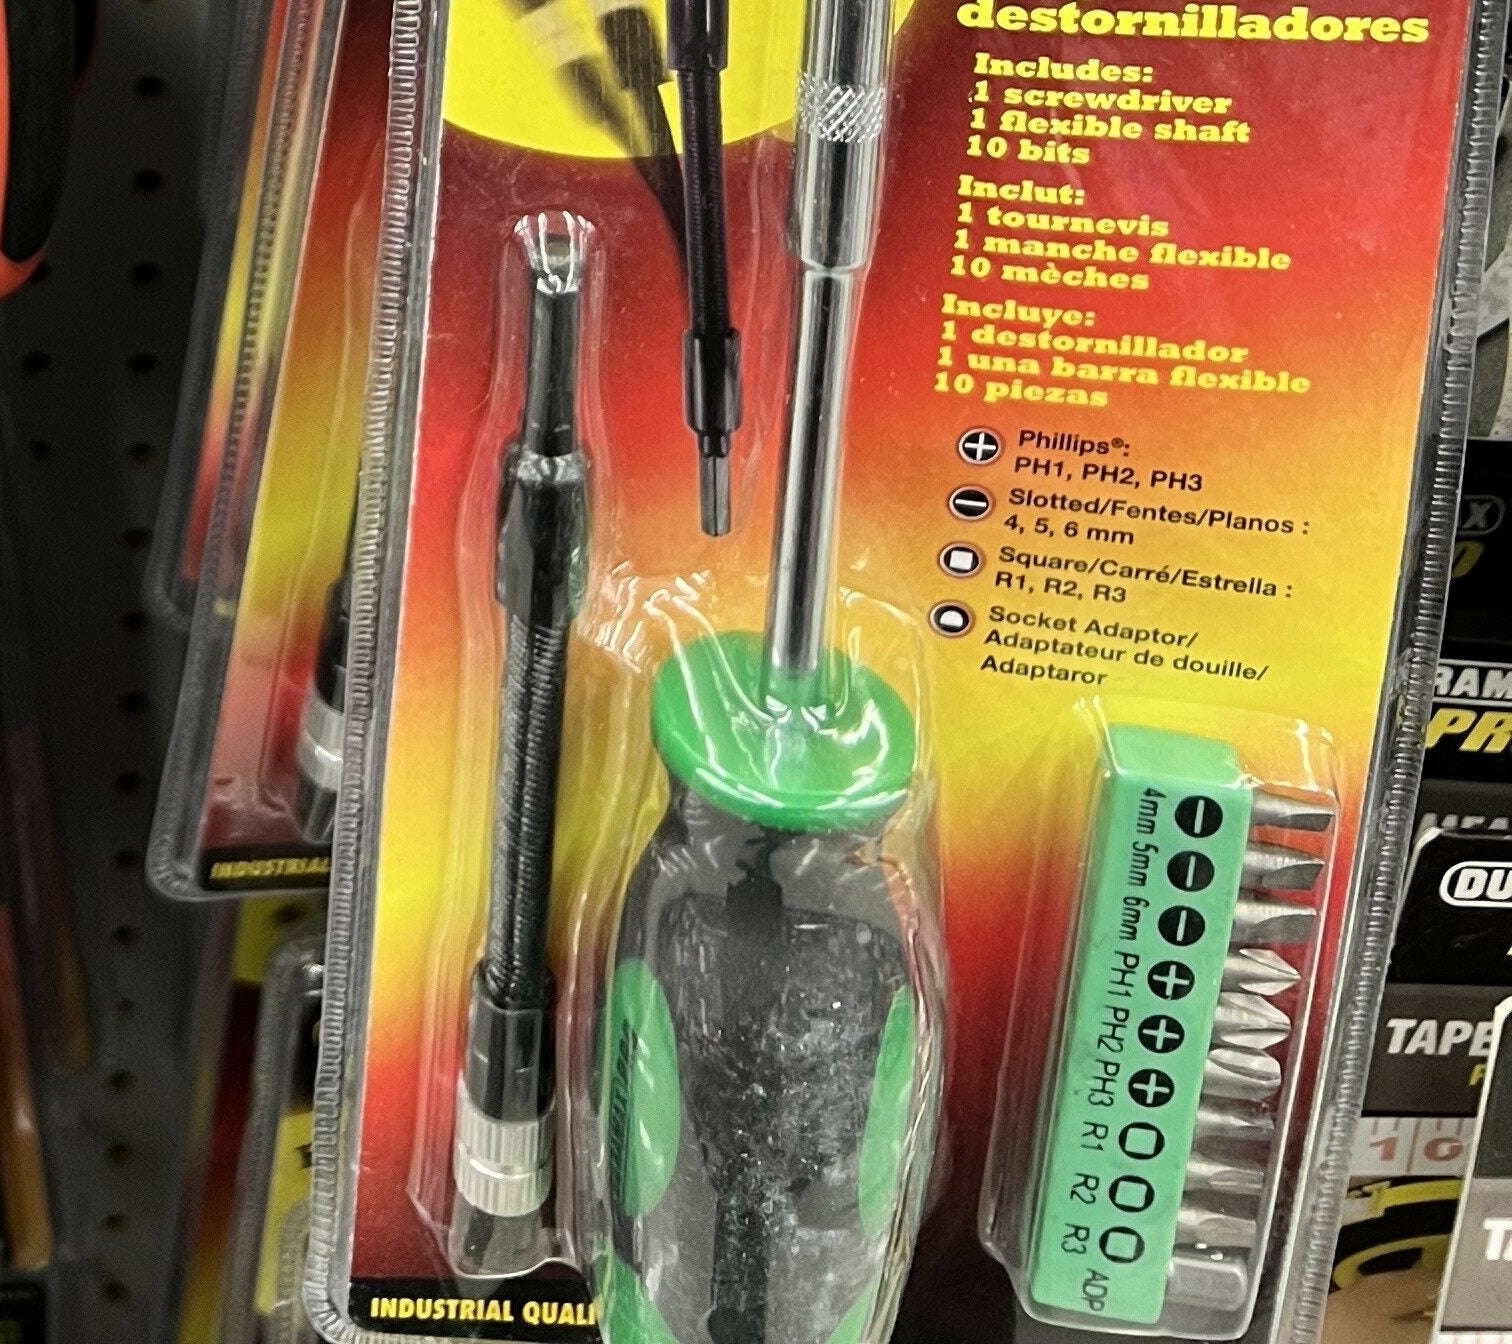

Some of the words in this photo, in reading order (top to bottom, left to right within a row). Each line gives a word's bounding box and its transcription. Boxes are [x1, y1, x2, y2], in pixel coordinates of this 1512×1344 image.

[957, 0, 1430, 45] destornilladores
[975, 53, 1153, 85] Includes:
[974, 82, 990, 103] 1
[1004, 87, 1232, 116] screwdriver
[970, 109, 986, 131] 1
[1000, 111, 1145, 142] flexible
[1155, 120, 1251, 146] shaft
[967, 135, 1007, 161] 10
[1018, 139, 1090, 166] bits
[958, 175, 1086, 207] Inclut:
[958, 203, 974, 224] 1
[987, 208, 1169, 238] tournevis
[954, 229, 970, 250] 1
[984, 234, 1139, 264] manche
[1150, 243, 1291, 272] flexible
[950, 256, 990, 280] 10
[1002, 261, 1149, 292] mèches
[942, 293, 1096, 330] Incluye:
[941, 321, 957, 343] 1
[971, 325, 1249, 365] destornillador
[938, 347, 954, 368] 1
[967, 353, 1040, 377] una
[1053, 358, 1159, 385] barra
[1170, 366, 1311, 394] flexible
[934, 371, 975, 395] 10
[985, 380, 1109, 409] piezas
[1014, 457, 1071, 482] PH1,
[1083, 463, 1141, 489] PH2,
[1151, 470, 1204, 492] PH3
[1004, 515, 1024, 536] 4,
[1035, 518, 1055, 539] 5,
[1065, 522, 1079, 539] 6
[1086, 526, 1135, 546] mm
[1008, 488, 1295, 536] Slotted/Fentes/Planos
[995, 571, 1033, 596] R1,
[1044, 577, 1084, 602] R2,
[1093, 582, 1127, 603] R3
[998, 546, 1277, 598] Square/Carré/Estrella
[990, 605, 1079, 634] Socket
[1084, 615, 1199, 648] Adaptor/
[981, 654, 1108, 686] Adaptaror
[985, 628, 1128, 661] Adaptateur
[1133, 645, 1167, 666] de
[1173, 650, 1269, 682] douille/
[1135, 788, 1165, 834] 4mm
[1128, 840, 1158, 887] 5mm
[1119, 896, 1149, 942] 6mm
[1105, 950, 1140, 998] PH1
[1096, 1005, 1131, 1052] PH2
[1087, 1060, 1121, 1107] PH3
[1082, 1121, 1108, 1150] R1
[1070, 1172, 1100, 1205] R2
[1061, 1223, 1091, 1254] R3
[1081, 1269, 1110, 1312] ADP
[370, 1297, 515, 1322] INDUSTRIAL
